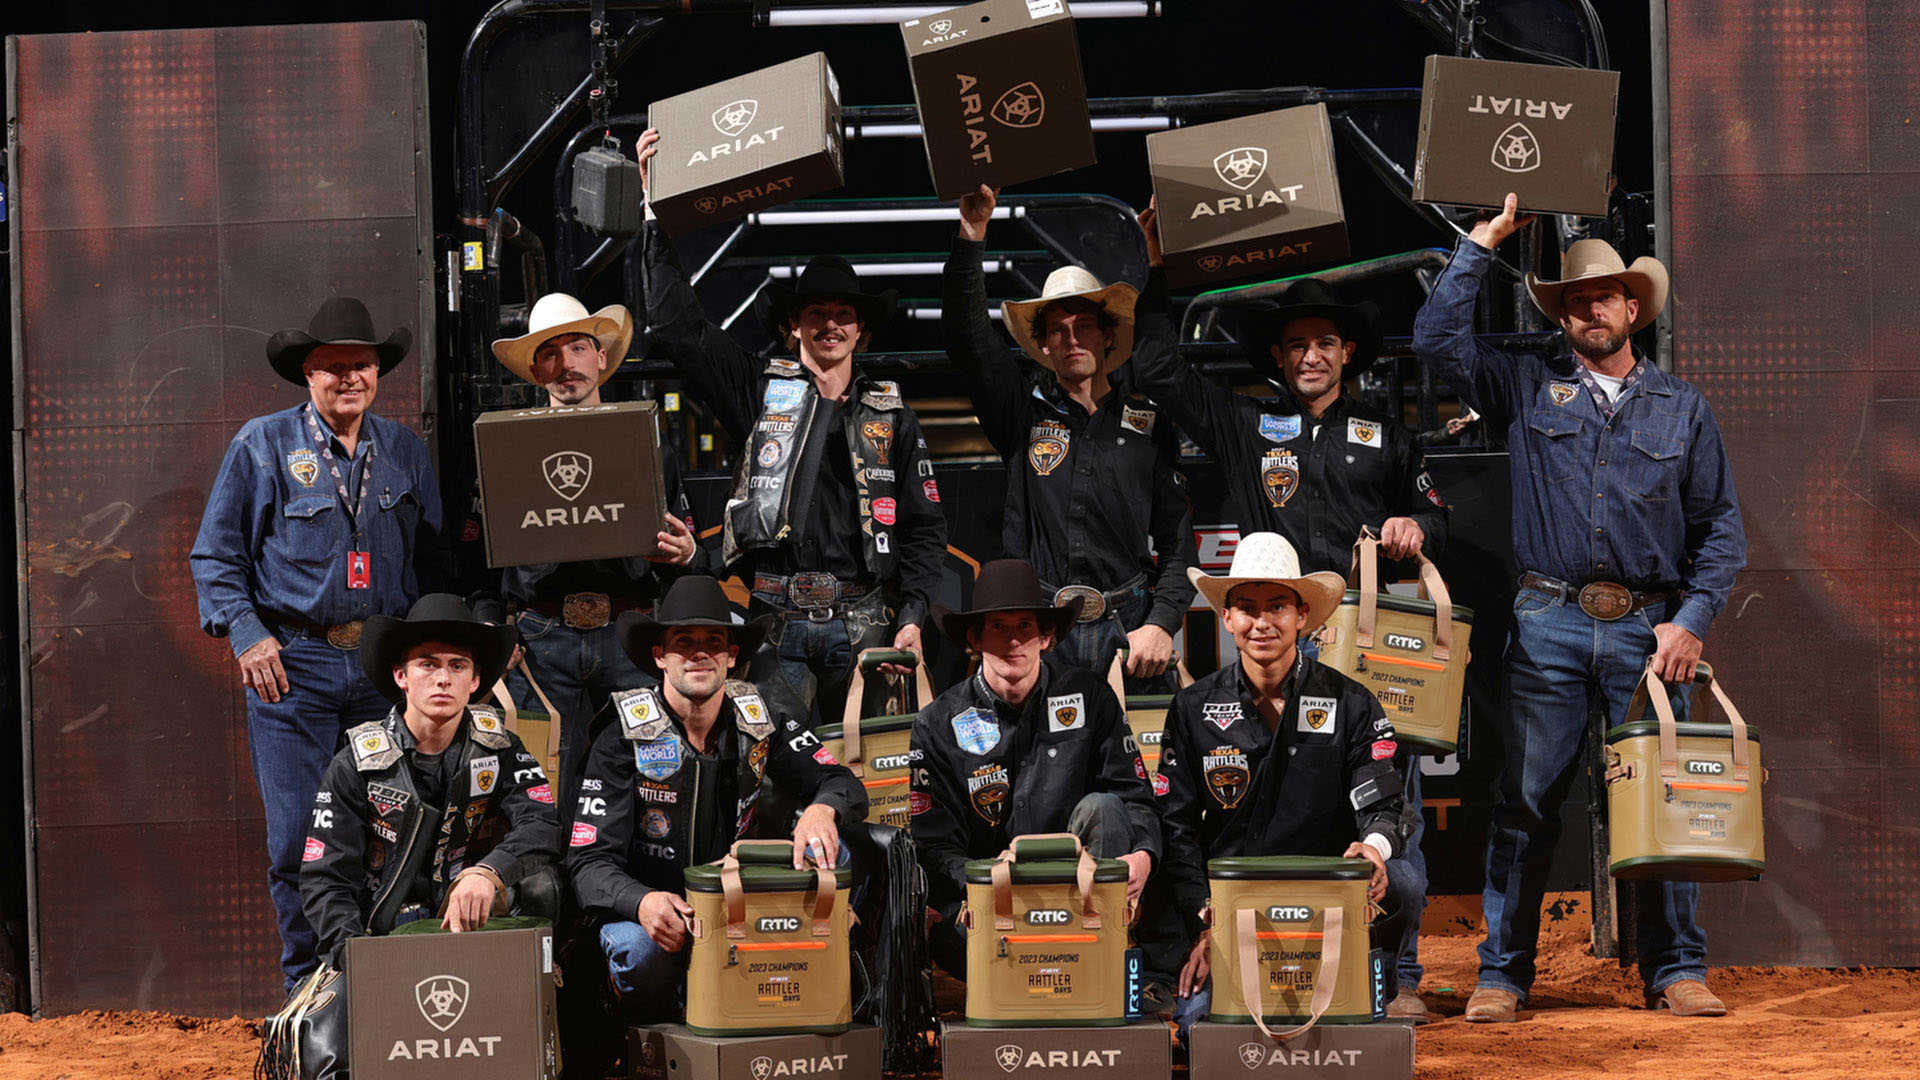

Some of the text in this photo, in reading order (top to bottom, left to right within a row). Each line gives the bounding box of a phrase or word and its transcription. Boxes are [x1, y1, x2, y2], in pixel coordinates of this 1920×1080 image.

[922, 29, 968, 46] ARIAT
[1468, 94, 1573, 120] ARIAT
[956, 73, 993, 164] ARIAT
[687, 126, 784, 167] ARIAT
[721, 176, 794, 208] ARIAT
[1190, 184, 1303, 220] ARIAT
[1226, 241, 1313, 267] ARIAT
[1350, 420, 1379, 429] ARIAT
[851, 452, 875, 538] ARIAT
[520, 503, 625, 529] ARIAT
[1388, 635, 1422, 650] RTIC
[1050, 697, 1081, 707] ARIAT
[1302, 700, 1335, 709] ARIAT
[1377, 690, 1415, 706] RATTLER
[1142, 733, 1162, 744] RT
[640, 749, 676, 762] WORLD
[1209, 748, 1241, 757] TEXAS
[471, 760, 498, 770] ARIAT
[876, 754, 910, 769] RTIC
[1202, 754, 1248, 770] RATTLERS
[1689, 761, 1723, 774] RTIC
[972, 765, 1003, 778] TEXAS
[968, 769, 1008, 794] RATTLERS
[1689, 818, 1726, 830] RATTLER
[1030, 911, 1069, 924] RTIC
[1271, 907, 1309, 920] RTIC
[760, 918, 799, 931] RTIC
[1018, 953, 1080, 964] 2023 CHAMPIONS
[1260, 950, 1322, 961] 2023 CHAMPIONS
[748, 962, 809, 973] 2023 CHAMPIONS
[1028, 974, 1072, 987] RATTLER
[1269, 971, 1313, 984] RATTLER
[758, 982, 800, 996] RATTLER
[1128, 958, 1140, 1013] RTIC
[1373, 958, 1386, 1013] RTIC
[387, 1036, 502, 1061] ARIAT
[773, 1054, 848, 1078] ARIAT
[1025, 1050, 1122, 1069] ARIAT
[1267, 1050, 1363, 1067] ARIAT
